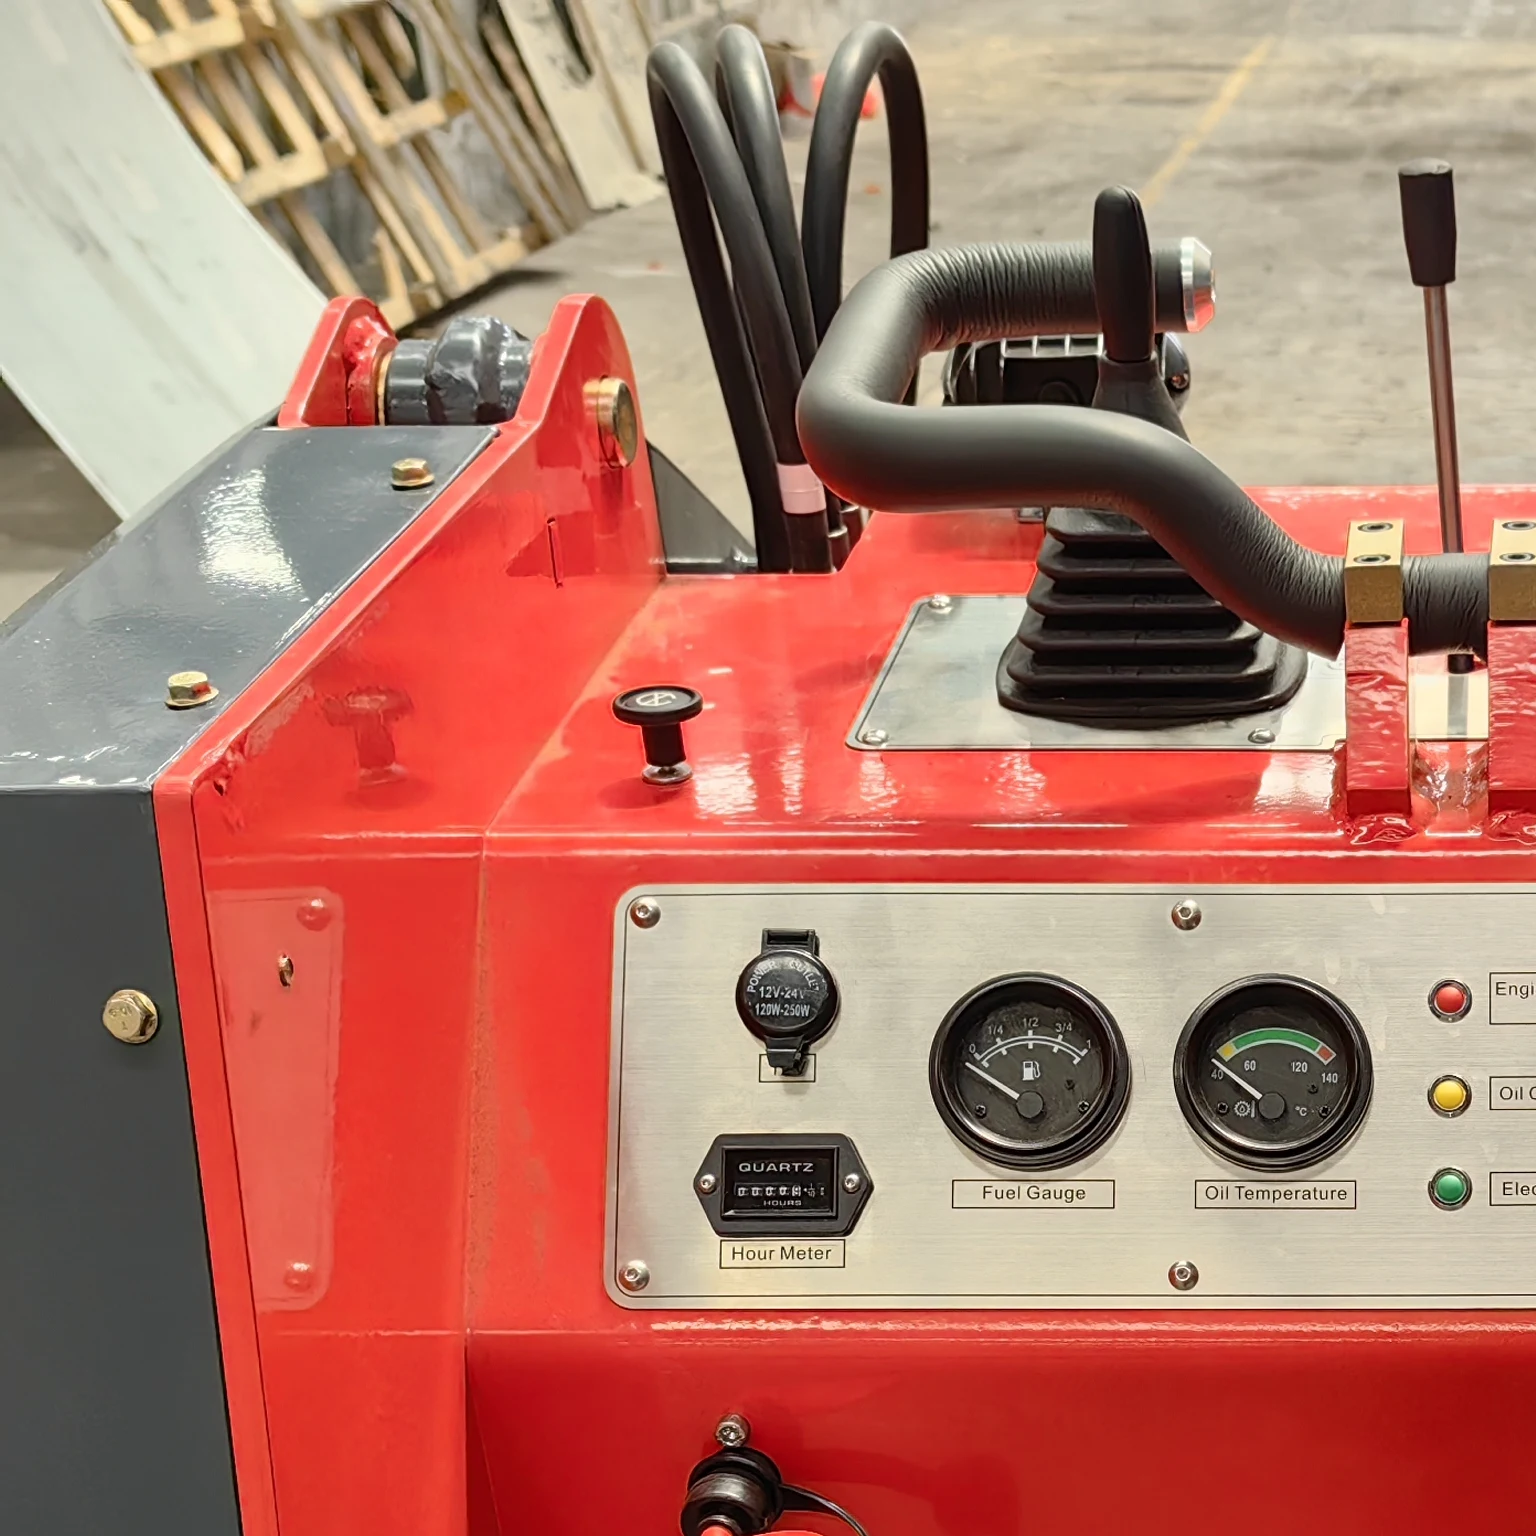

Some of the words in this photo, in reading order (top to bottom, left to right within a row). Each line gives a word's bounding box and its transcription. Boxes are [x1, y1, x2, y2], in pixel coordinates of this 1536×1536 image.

[747, 959, 778, 993] POWER
[1022, 1017, 1039, 1028] 1/2
[1055, 1023, 1073, 1033] 3/4
[1244, 1060, 1256, 1071] 60
[1291, 1061, 1308, 1073] 120
[1211, 1069, 1224, 1080] 40
[1321, 1073, 1338, 1084] 140
[1499, 1086, 1524, 1101] Oil
[738, 1162, 814, 1173] QUARTZ
[982, 1185, 1021, 1200] Fuel
[1026, 1185, 1087, 1204] Gauge
[1205, 1185, 1229, 1201] Oil
[1234, 1185, 1348, 1204] Temperature
[731, 1246, 775, 1261] Hour
[780, 1245, 832, 1261] Meter
